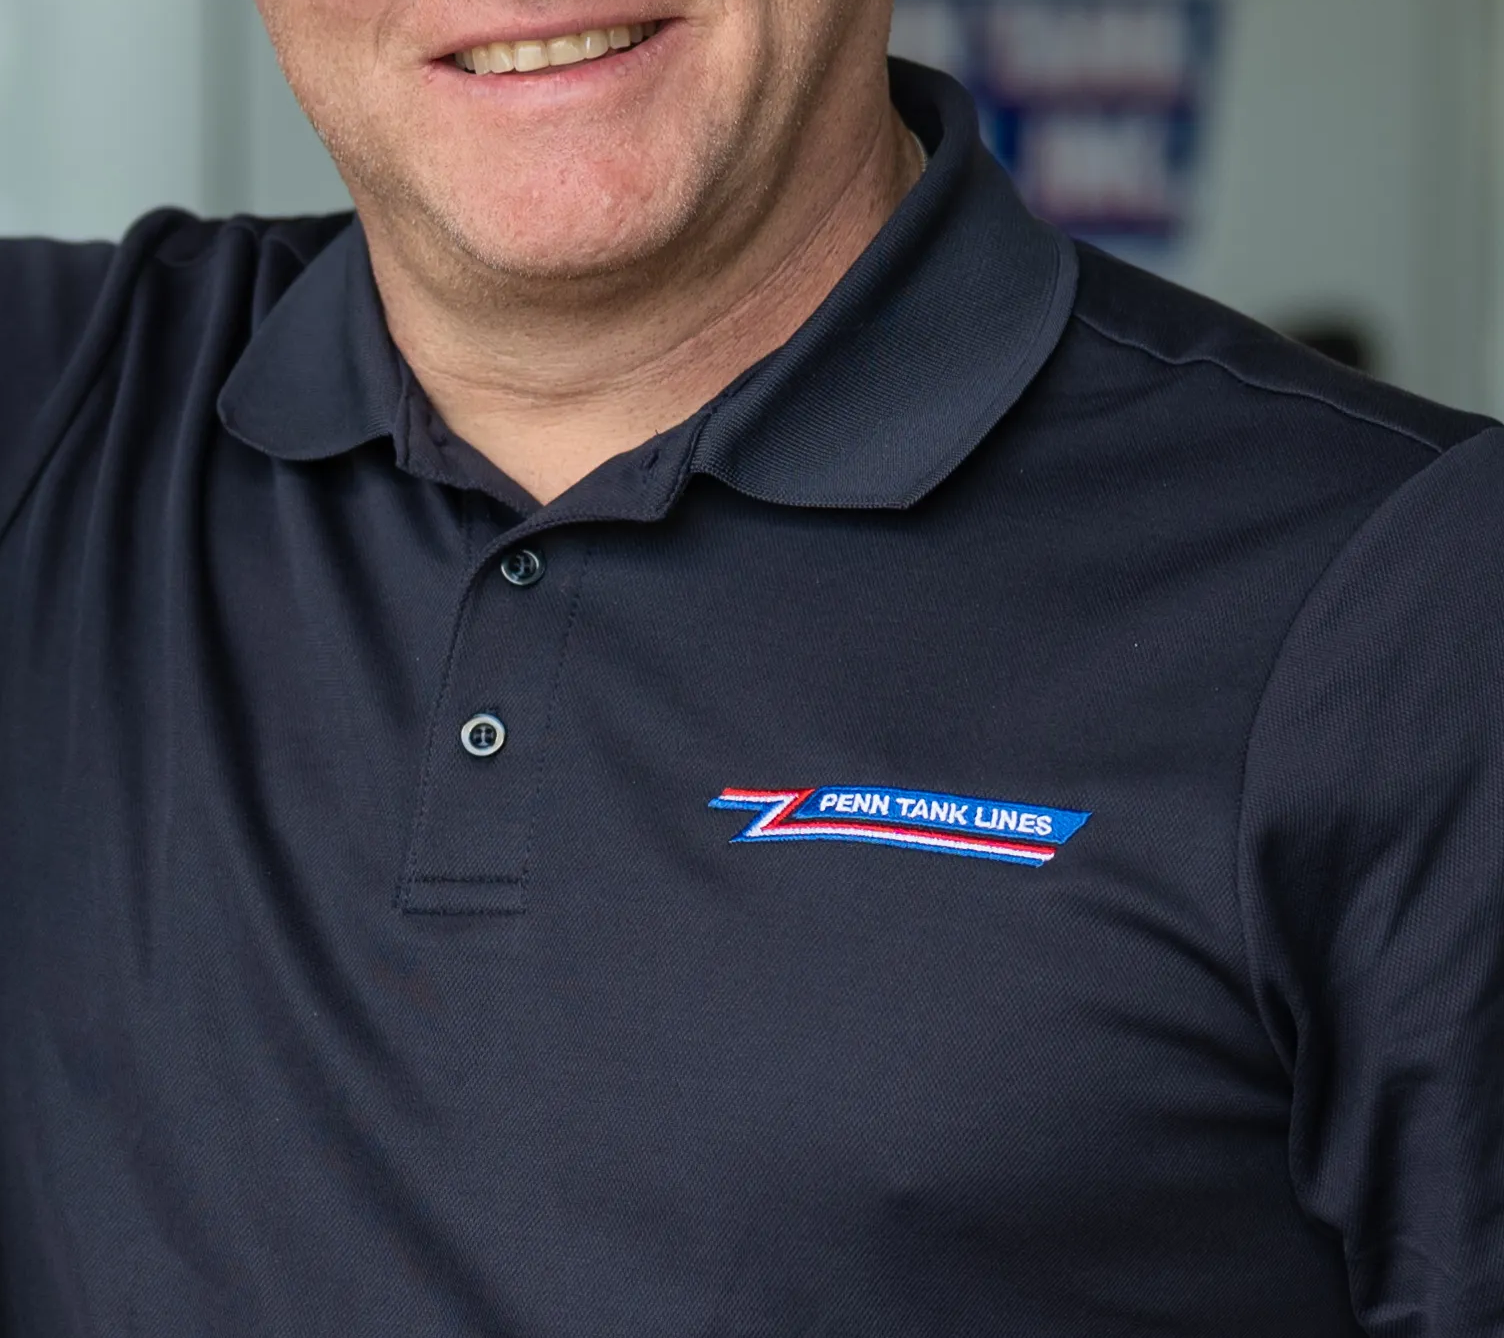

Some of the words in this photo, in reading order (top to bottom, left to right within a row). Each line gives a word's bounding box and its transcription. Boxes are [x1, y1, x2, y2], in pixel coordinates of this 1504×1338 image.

[818, 792, 891, 816] PENN
[895, 797, 969, 826] TANK
[974, 806, 1053, 836] LINES
